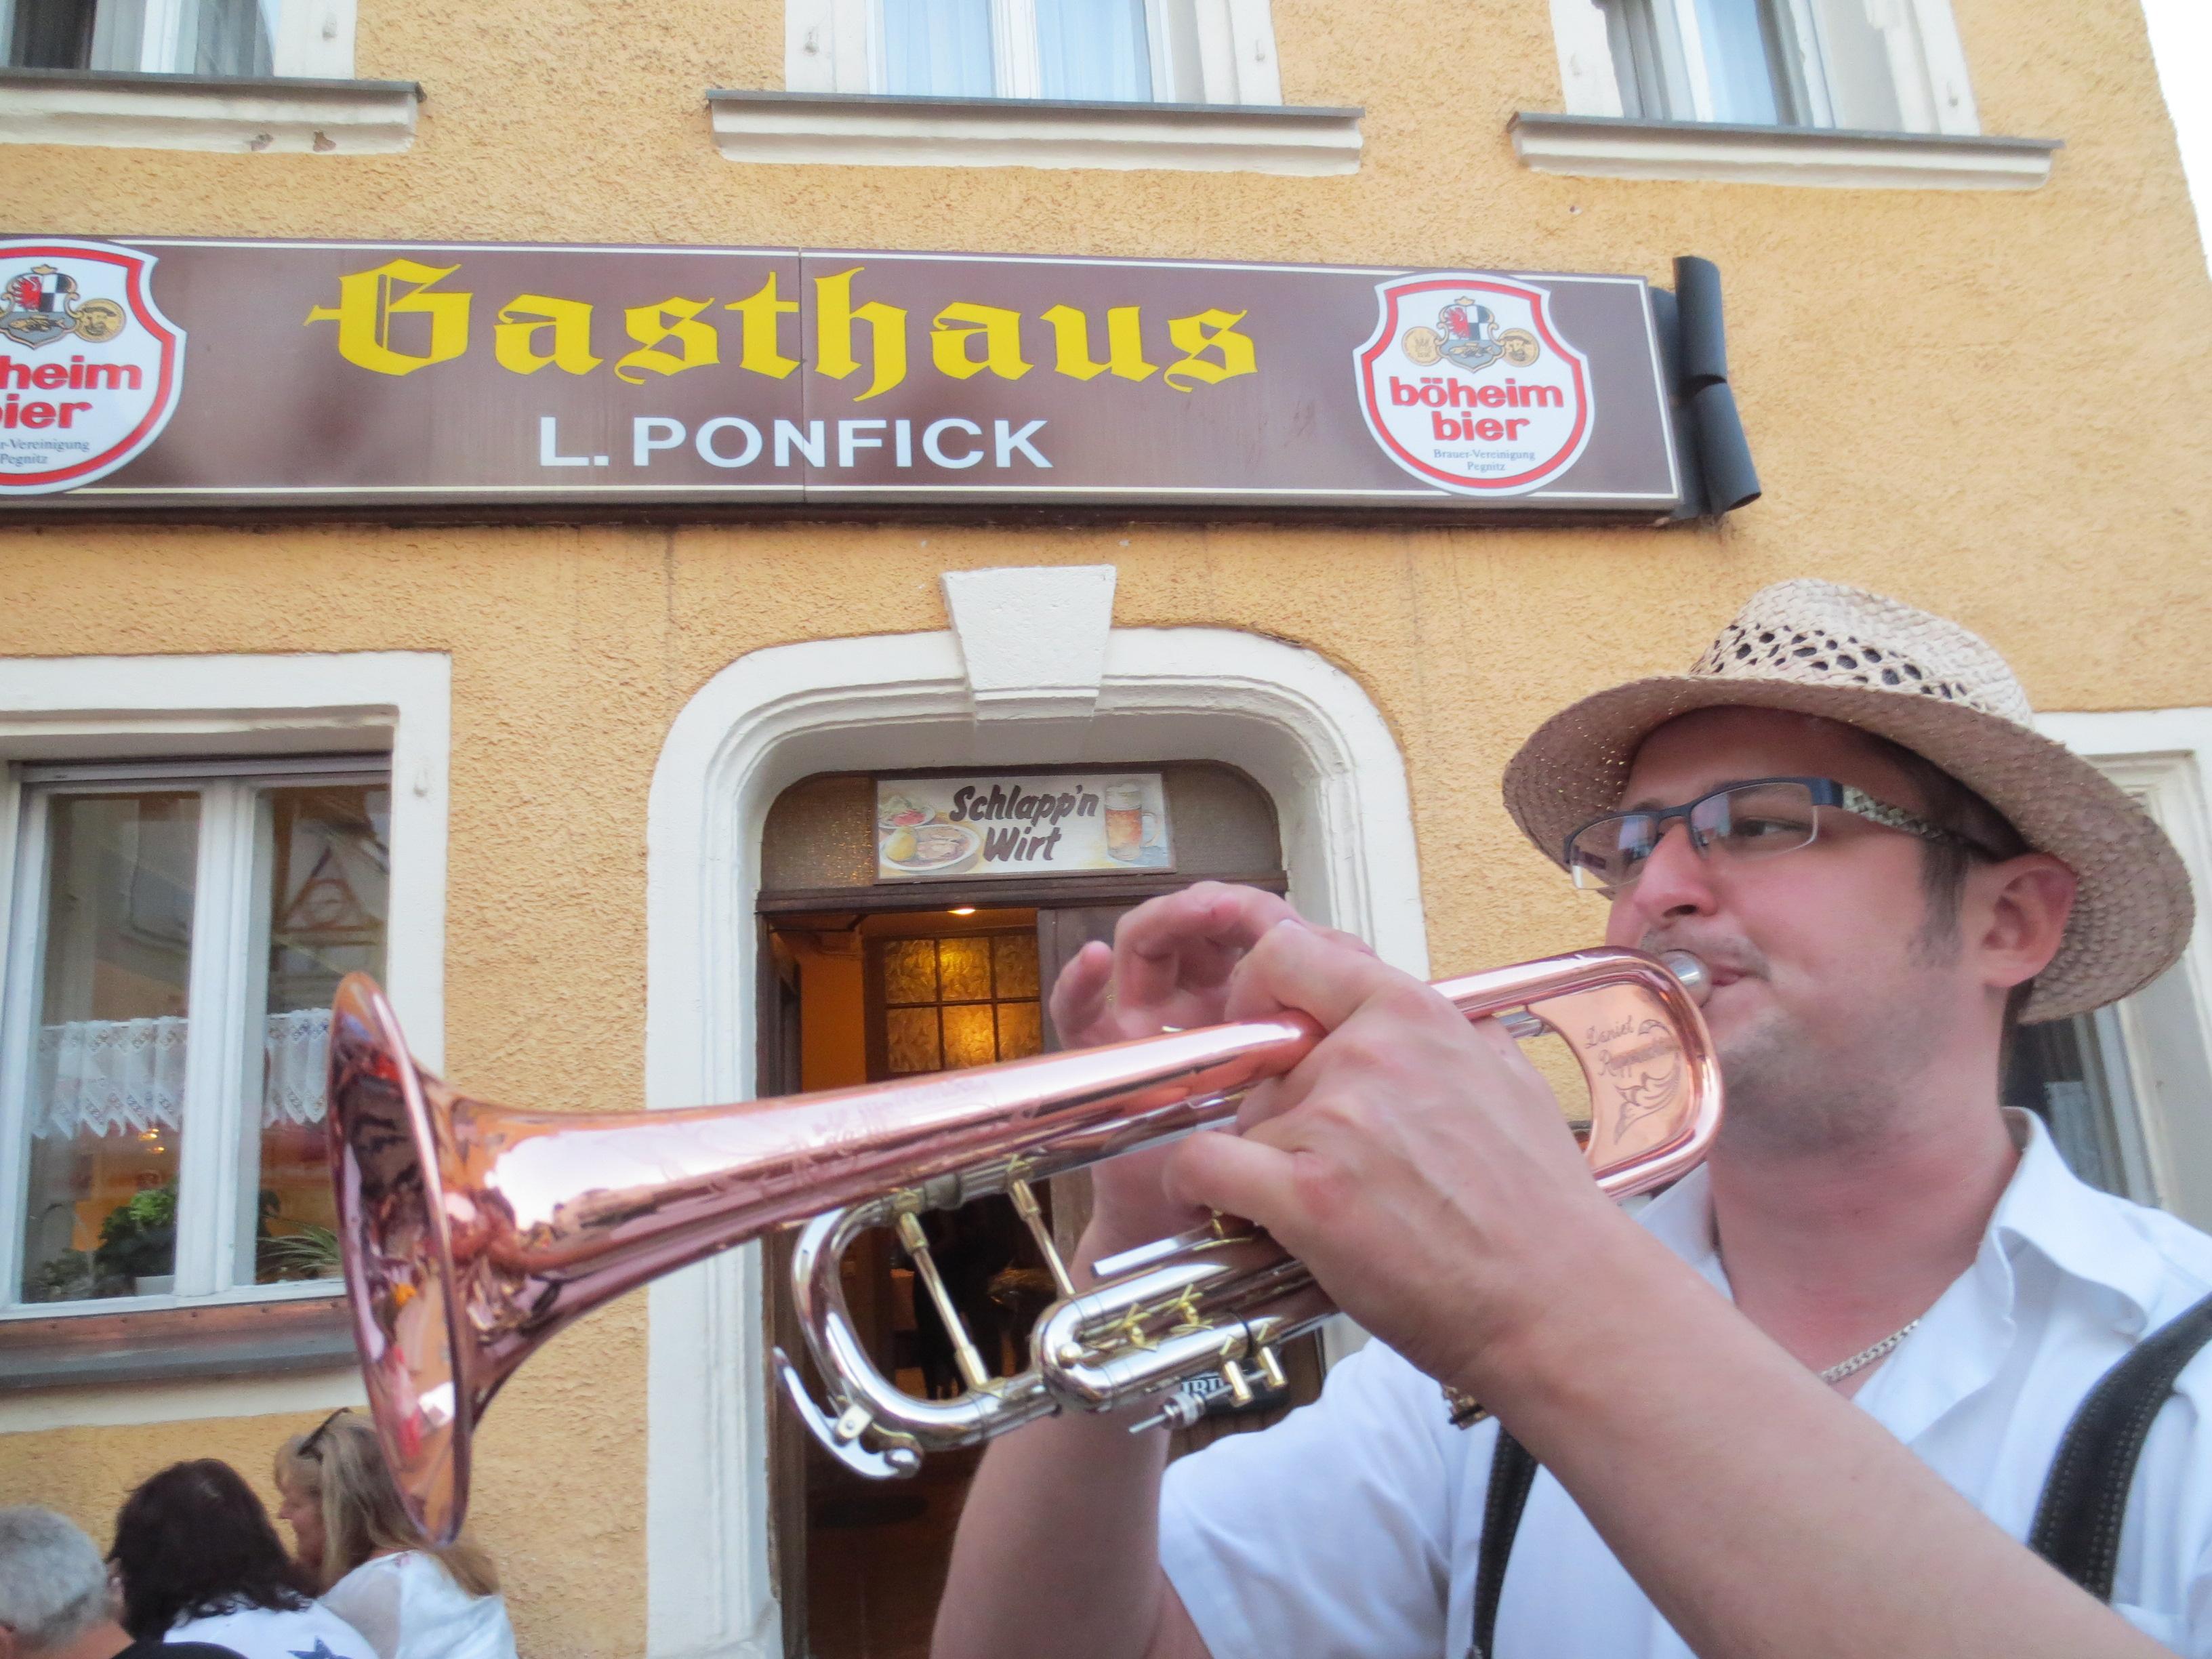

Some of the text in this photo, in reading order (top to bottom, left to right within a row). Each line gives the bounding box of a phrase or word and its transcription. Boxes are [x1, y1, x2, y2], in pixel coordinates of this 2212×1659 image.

[304, 258, 1258, 402] Gasthaus
[1389, 376, 1563, 408] böheim
[0, 394, 92, 428] ier
[1431, 411, 1530, 441] bier
[540, 416, 1053, 468] L. PONFICK
[1433, 449, 1536, 461] Brauer-Vereinigung
[1, 453, 48, 467] Pegnitz
[1467, 462, 1507, 472] Pegnitz
[949, 783, 1099, 826] Schlapp'n
[983, 826, 1061, 862] Wirt
